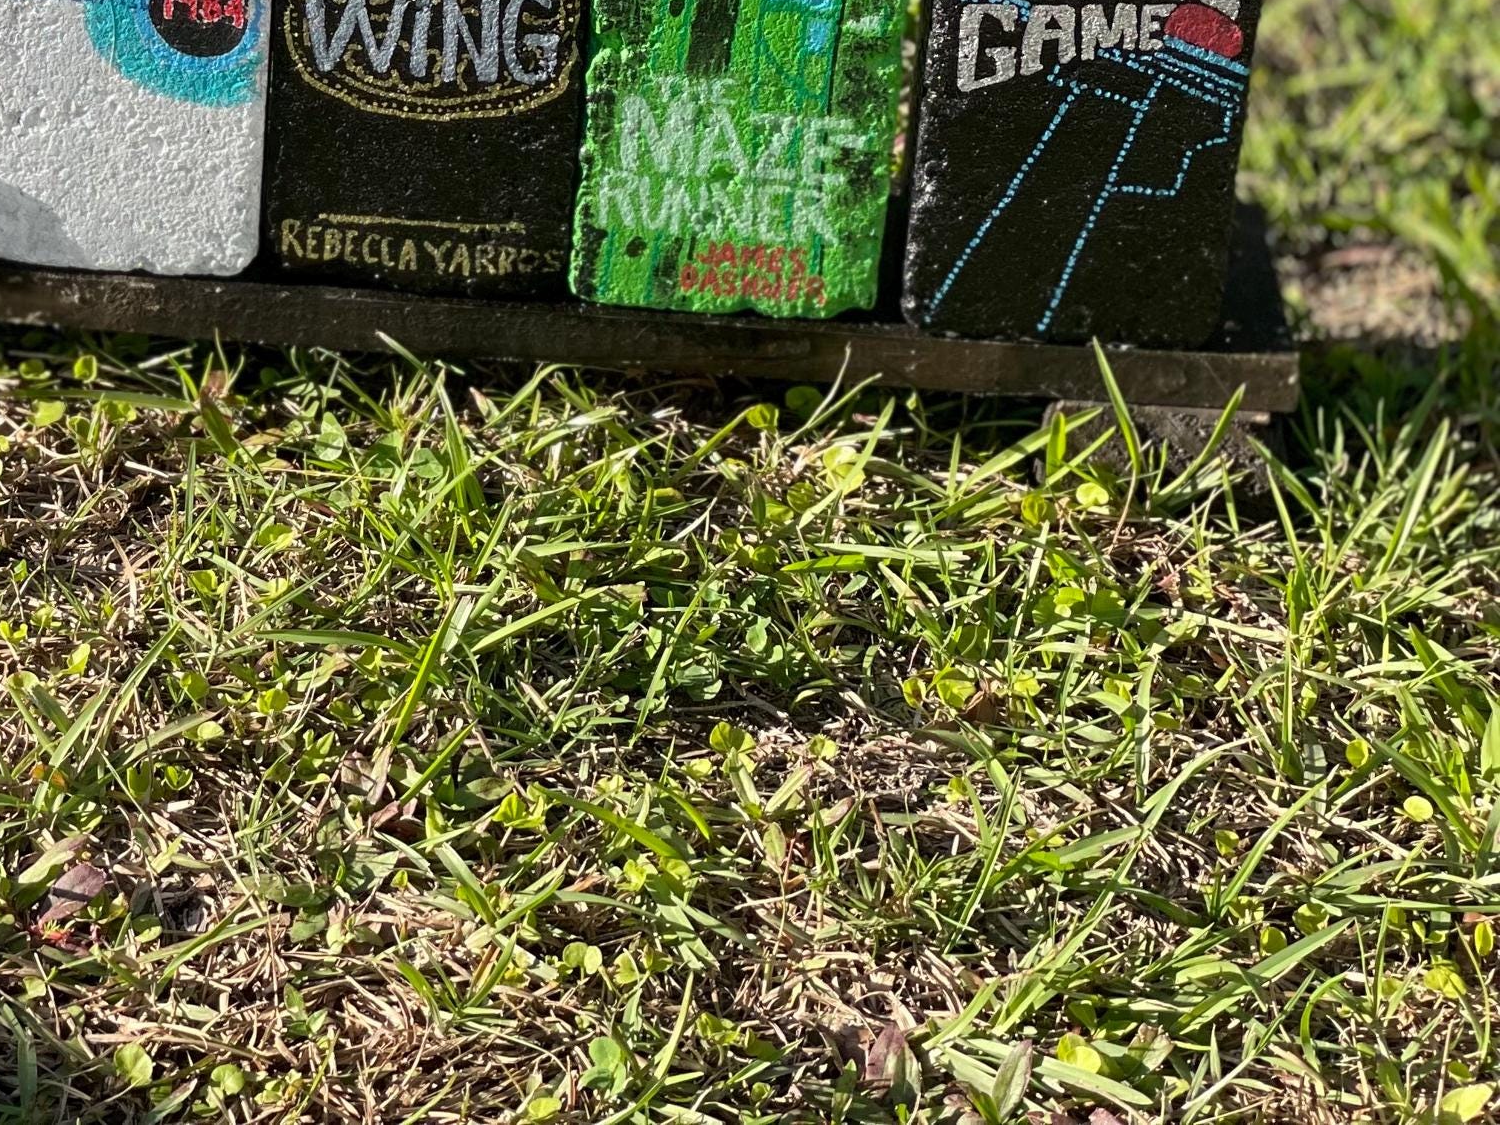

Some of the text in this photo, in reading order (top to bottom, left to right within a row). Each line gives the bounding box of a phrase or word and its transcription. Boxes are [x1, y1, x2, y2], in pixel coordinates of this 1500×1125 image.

[956, 2, 1178, 93] GAME
[618, 92, 877, 186] MAZE
[598, 170, 839, 247] RUNNER
[280, 218, 564, 277] REBECCA YARROS
[696, 240, 807, 277] JAMES
[678, 263, 827, 307] DASHNER
